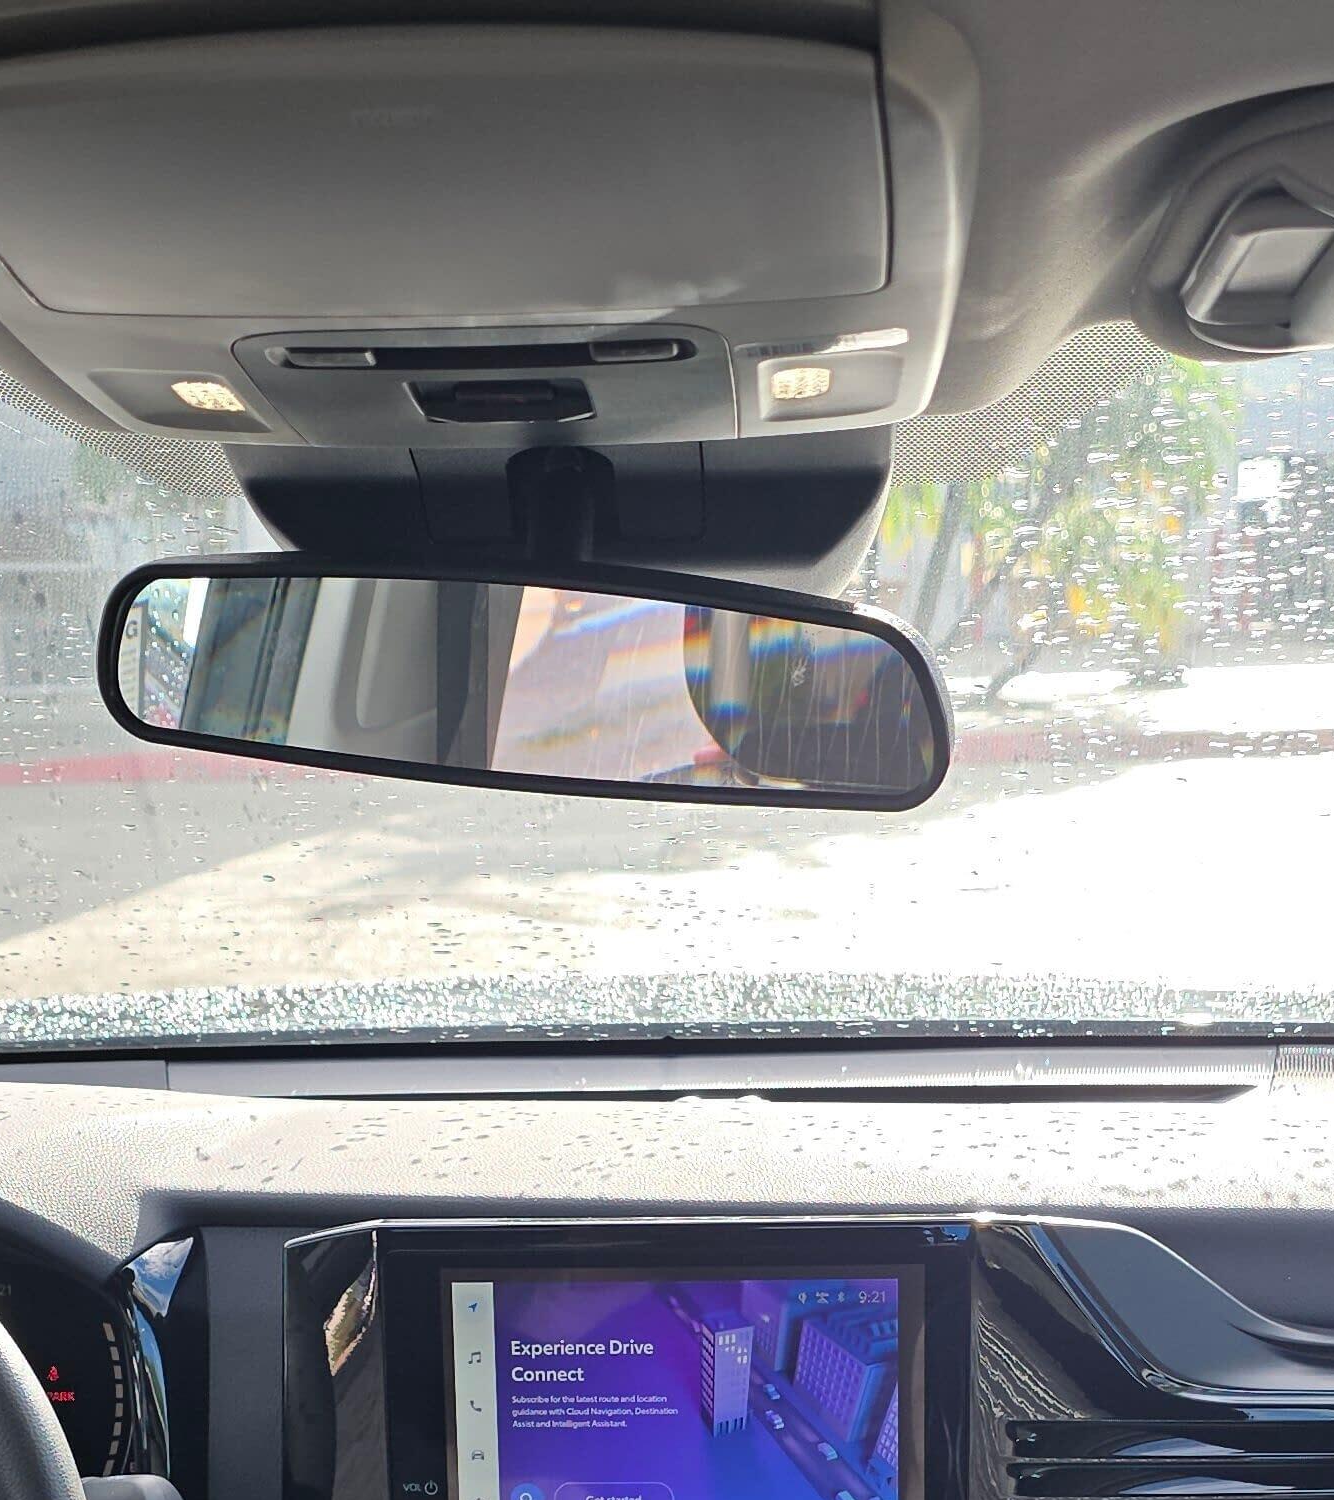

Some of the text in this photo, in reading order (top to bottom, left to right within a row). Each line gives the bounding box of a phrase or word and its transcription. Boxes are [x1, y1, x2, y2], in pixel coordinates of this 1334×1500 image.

[858, 1290, 886, 1303] 9:21
[510, 1338, 654, 1358] Experience Drive
[511, 1366, 585, 1382] Connect
[512, 1395, 668, 1404] Subscribe for the latest route and location
[512, 1407, 679, 1417] guidance with Cloud Navigation, Destination
[512, 1420, 628, 1429] Assist and Intelligent Assistant.
[402, 1483, 421, 1492] VOL
